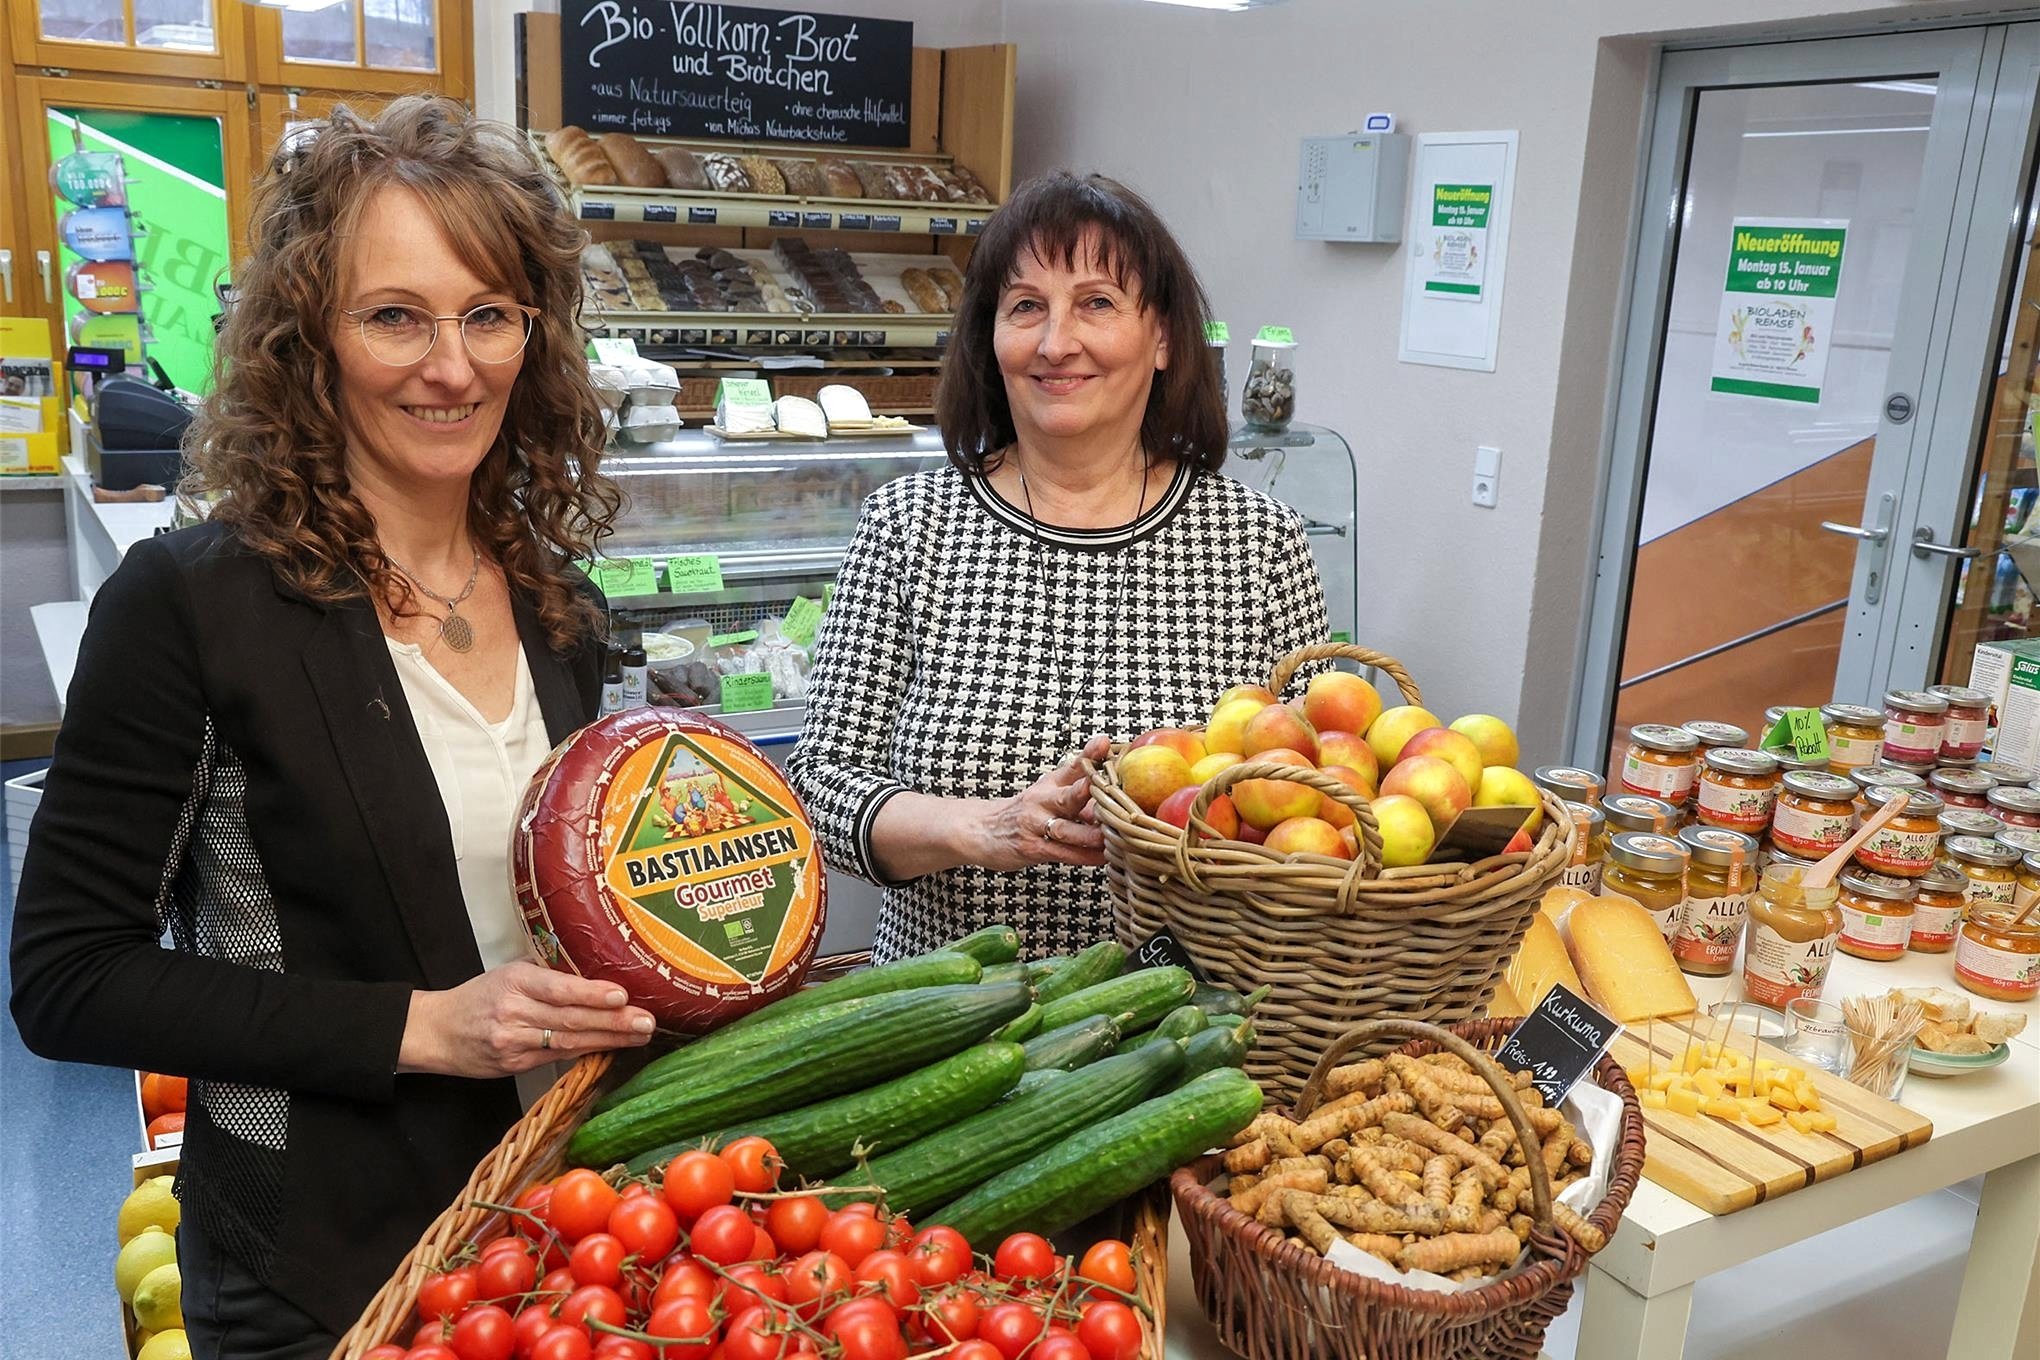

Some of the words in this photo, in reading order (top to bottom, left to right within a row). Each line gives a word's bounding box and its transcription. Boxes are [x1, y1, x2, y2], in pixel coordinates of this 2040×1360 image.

[672, 53, 713, 76] und
[717, 54, 834, 96] Brötchen
[596, 83, 623, 97] aus
[629, 77, 753, 121] Natursauerteig
[597, 108, 627, 124] immer
[791, 101, 813, 117] ohne
[816, 103, 862, 121] chemische
[708, 122, 725, 135] von
[765, 119, 848, 143] Naturbackstube
[1436, 187, 1490, 204] Neueröffnung
[1437, 204, 1459, 216] Montag
[1736, 232, 1841, 258] Neueröffnung
[1736, 258, 1777, 276] Montag
[1778, 260, 1792, 274] 15.
[1793, 261, 1832, 277] Januar
[1756, 277, 1772, 290] ab
[1773, 279, 1786, 291] 10
[1788, 278, 1810, 292] Uhr
[1746, 306, 1807, 320] BIOLADEN
[1755, 317, 1795, 329] REMSE
[2013, 660, 2040, 675] Salus
[1794, 711, 1811, 730] 10%
[1794, 732, 1822, 757] Rabatt
[625, 826, 798, 888] BASTIAANSEN
[676, 866, 775, 907] Gourmet
[698, 892, 766, 922] Superieur
[1708, 900, 1748, 917] ALLO
[1541, 988, 1600, 1049] Kurkuma
[1504, 1039, 1531, 1065] Preis:
[1532, 1061, 1559, 1080] 1,99
